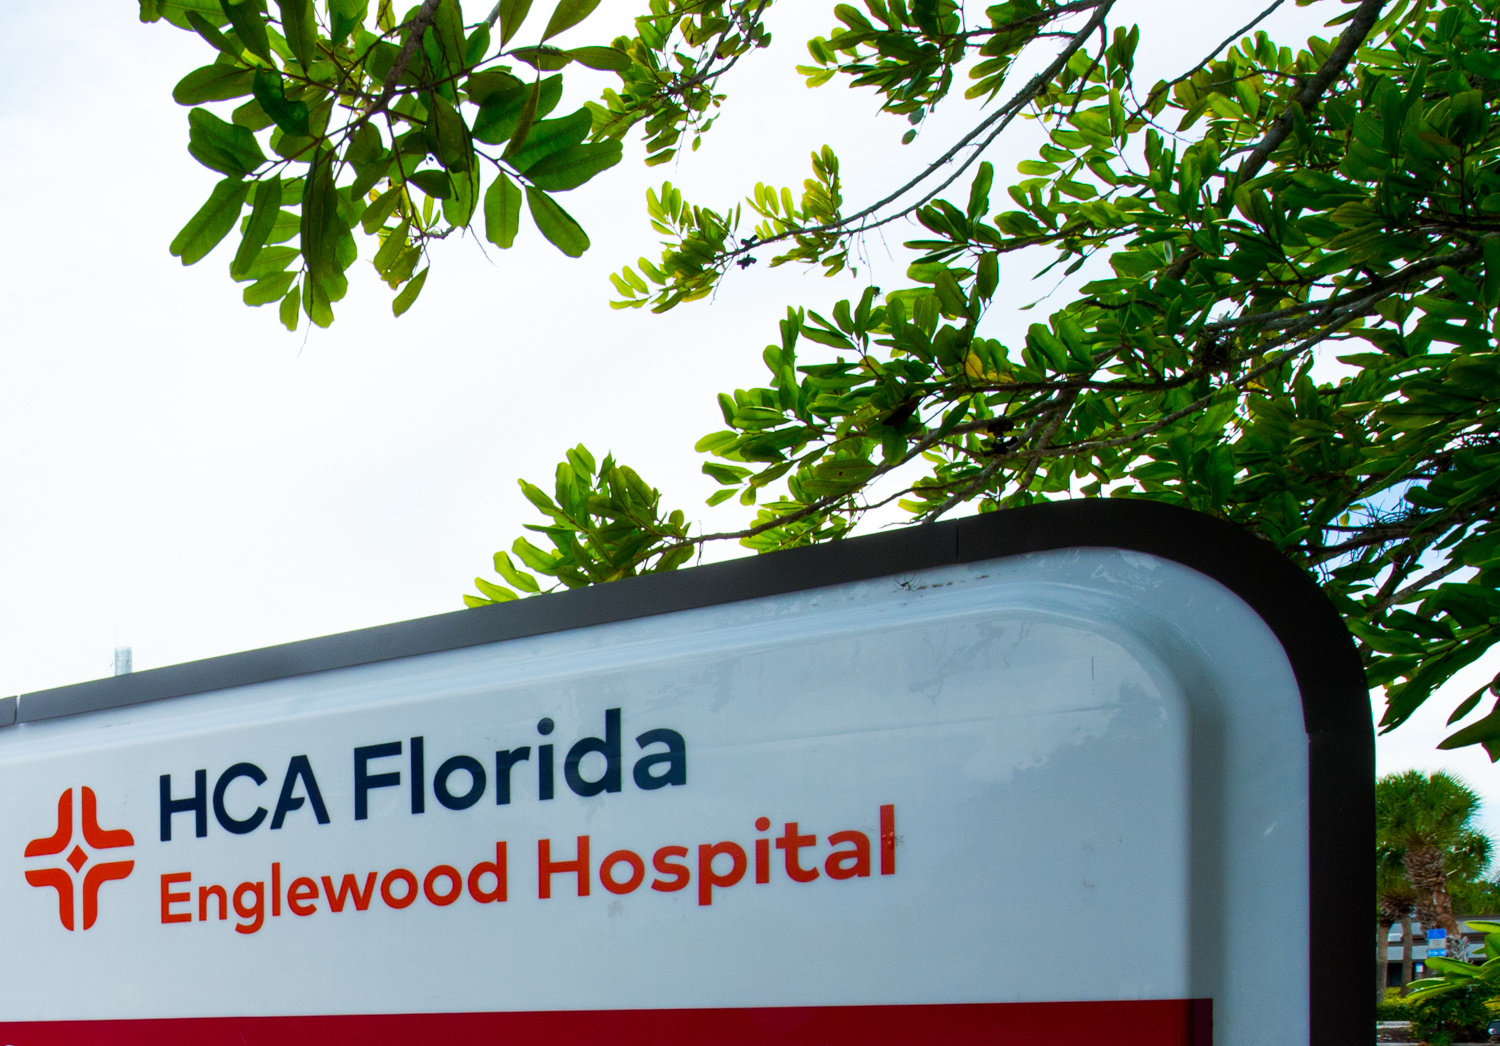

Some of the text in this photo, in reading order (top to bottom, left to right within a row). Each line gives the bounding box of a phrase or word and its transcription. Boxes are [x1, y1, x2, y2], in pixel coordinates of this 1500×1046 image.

[159, 707, 688, 842] HCA Florida
[160, 804, 896, 935] Englewood Hospital
